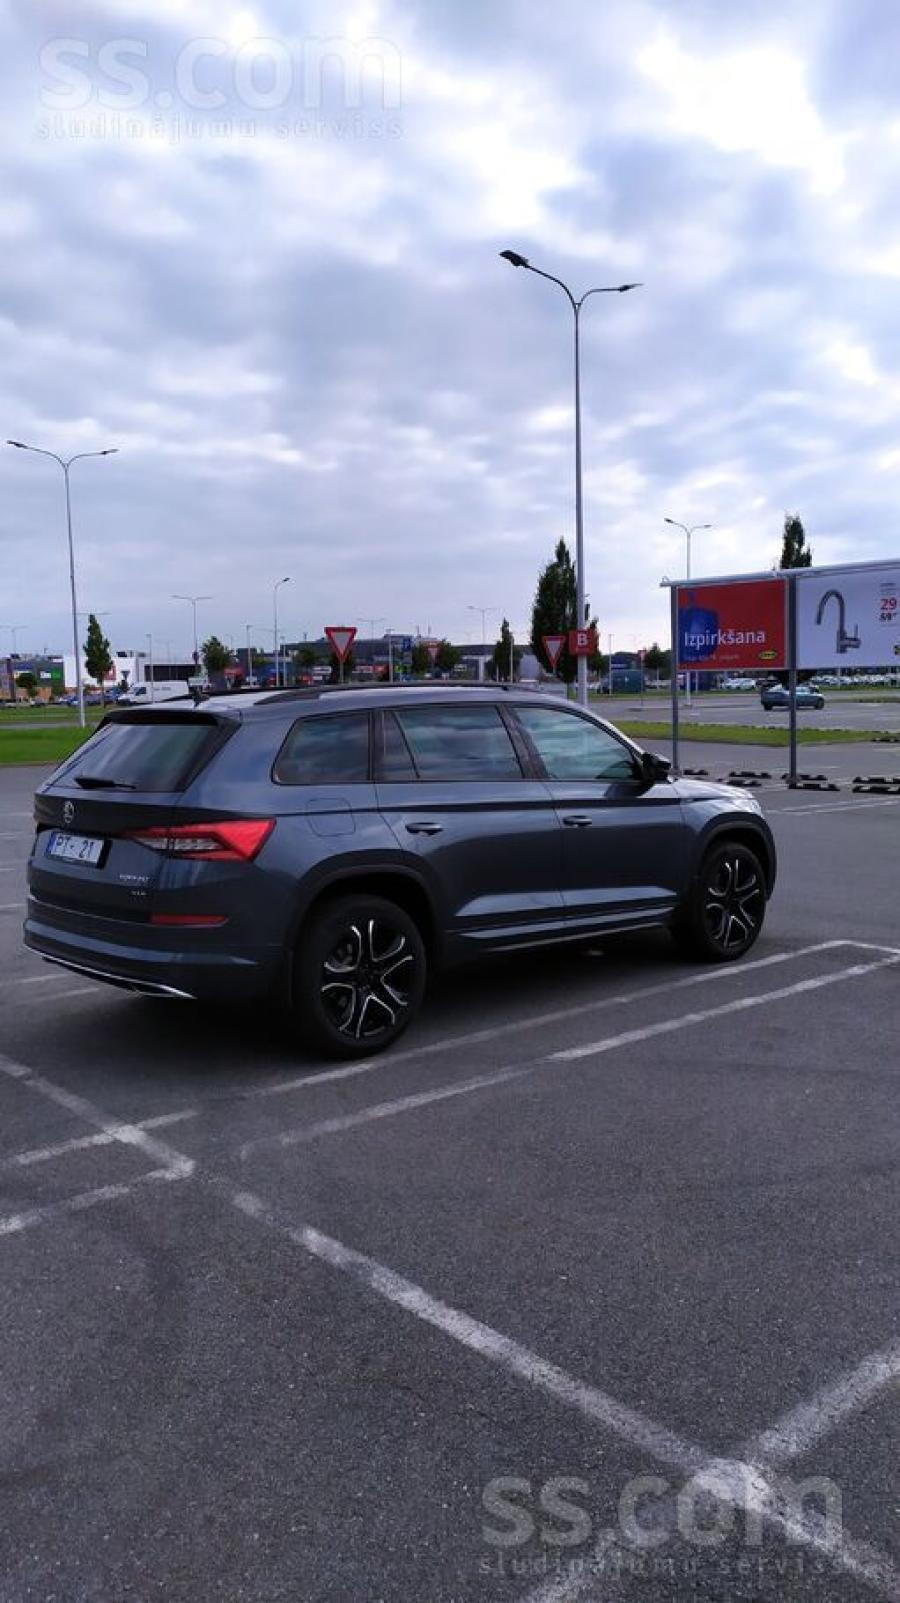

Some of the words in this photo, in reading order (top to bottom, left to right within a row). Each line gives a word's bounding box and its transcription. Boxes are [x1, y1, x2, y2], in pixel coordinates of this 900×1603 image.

[880, 597, 897, 611] 29
[577, 632, 589, 647] B
[684, 628, 766, 651] Izpirkšana
